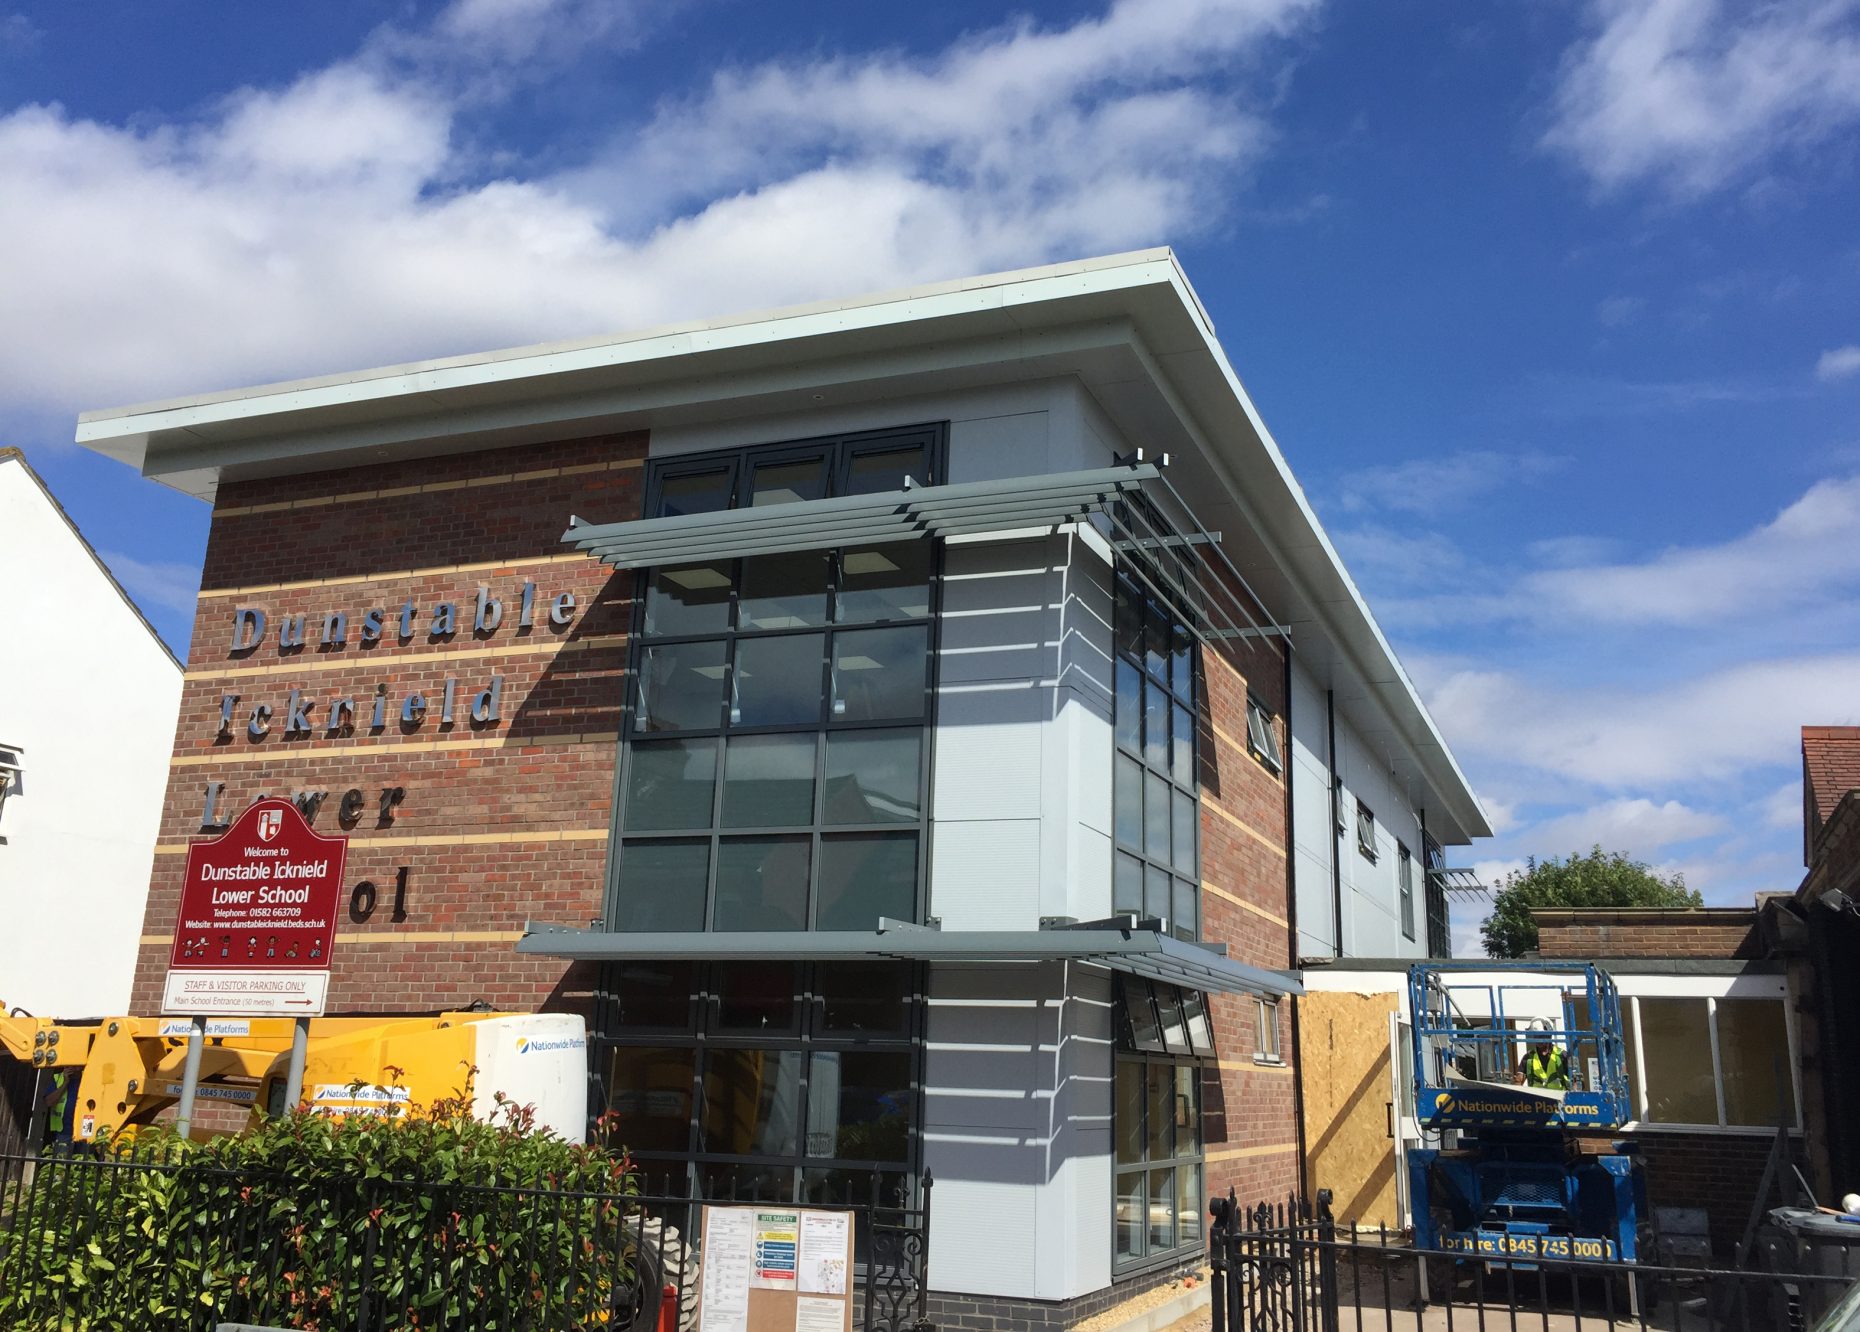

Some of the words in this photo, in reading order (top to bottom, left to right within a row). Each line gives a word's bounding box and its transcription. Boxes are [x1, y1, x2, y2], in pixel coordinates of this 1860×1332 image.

[230, 581, 578, 653] Dunstable
[218, 675, 504, 738] Icknield
[202, 782, 406, 829] Lwer
[244, 847, 278, 857] Welcome
[280, 847, 289, 857] to
[201, 861, 271, 881] Dunstable
[273, 859, 328, 879] Icknield
[211, 887, 255, 904] Lower
[257, 885, 310, 904] School
[213, 908, 247, 919] Telephone:
[249, 908, 271, 917] 01582
[272, 907, 302, 917] 663709
[185, 920, 212, 929] Website:
[184, 980, 207, 990] STAFF
[208, 980, 215, 990] &
[216, 981, 248, 990] VISITOR
[249, 981, 283, 991] PARKING
[285, 982, 307, 991] ONLY
[174, 996, 189, 1004] Main
[190, 996, 212, 1005] School
[213, 997, 241, 1005] Entrance
[171, 1024, 213, 1034] Natiode
[214, 1024, 249, 1034] Platforms
[531, 1039, 569, 1051] Nationwide
[200, 1088, 218, 1097] 0845
[219, 1089, 232, 1098] 745
[233, 1090, 252, 1099] 0000
[326, 1088, 370, 1098] Nationide
[1458, 1100, 1533, 1114] Nationwide
[1535, 1101, 1599, 1115] Platorms
[1463, 1237, 1496, 1251] hre:
[1541, 1240, 1569, 1255] 745
